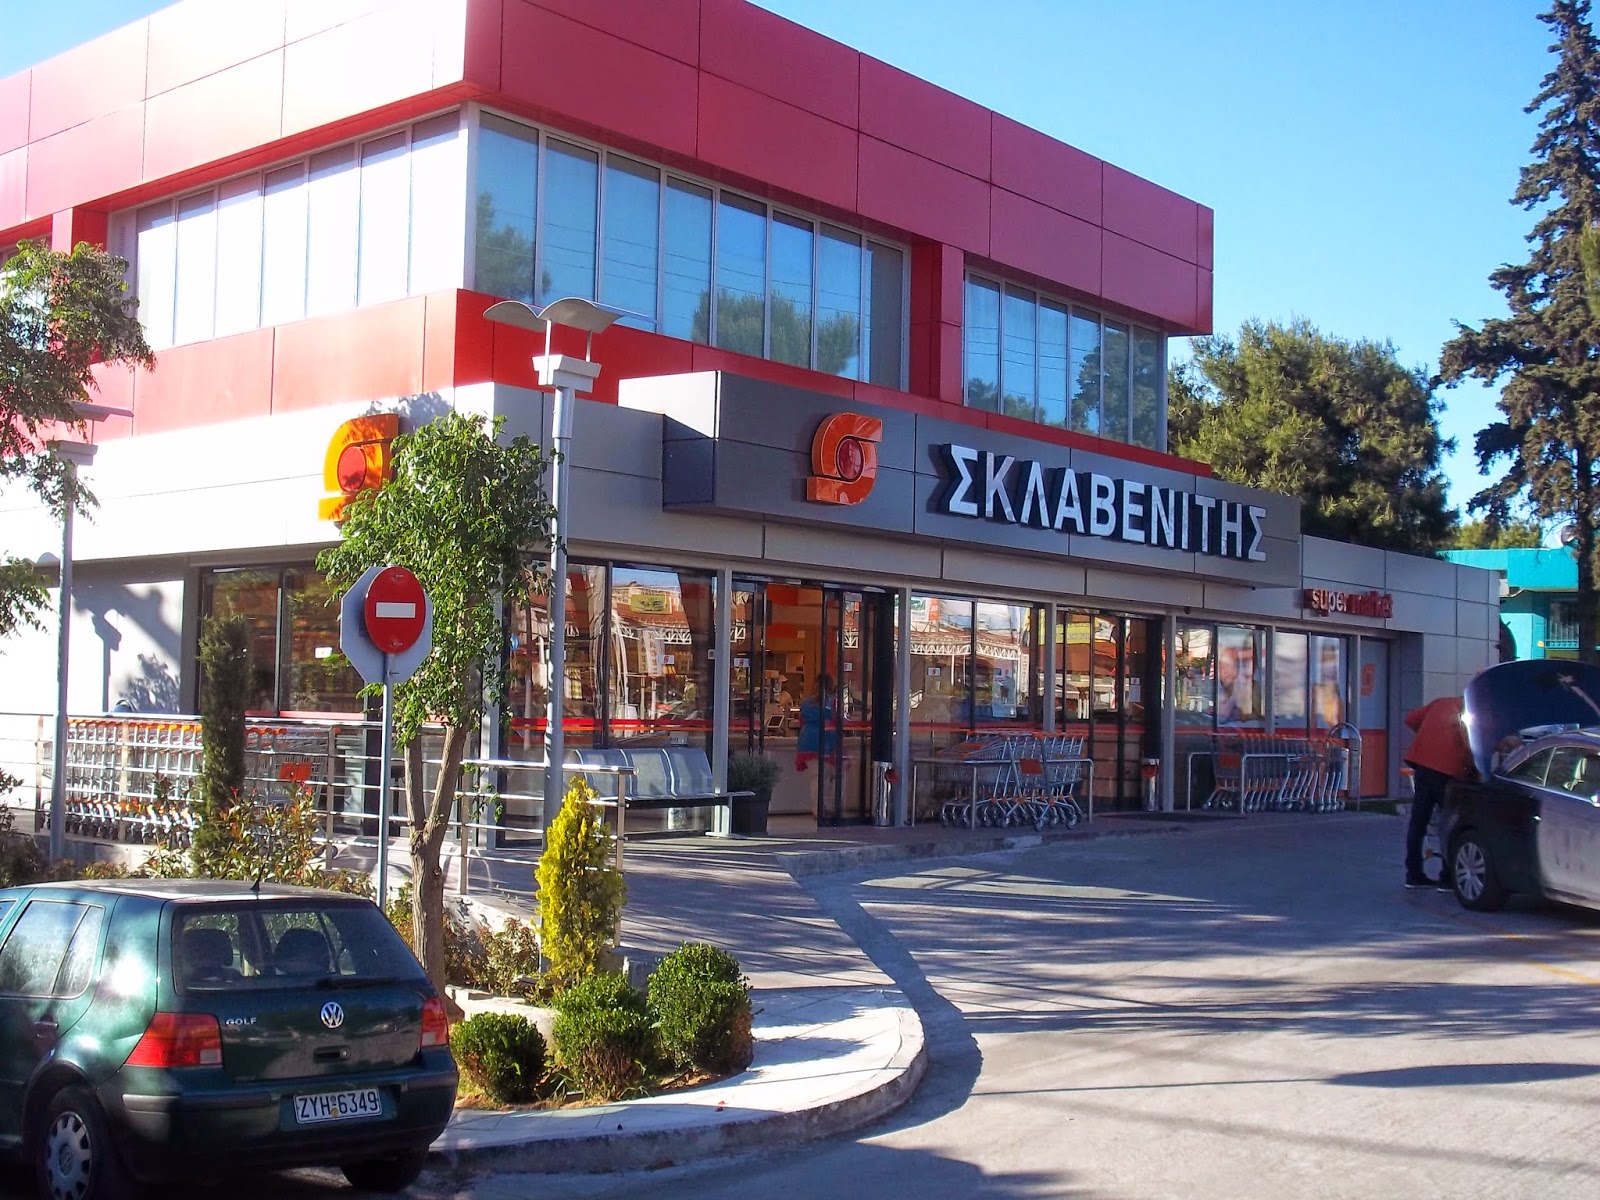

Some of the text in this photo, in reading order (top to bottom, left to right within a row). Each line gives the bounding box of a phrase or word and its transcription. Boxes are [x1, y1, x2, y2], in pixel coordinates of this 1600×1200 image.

[949, 444, 1267, 562] ΣΚΛΑΒΕΝΙΤΗΣ
[1311, 588, 1348, 615] super
[225, 1016, 257, 1026] GOLF
